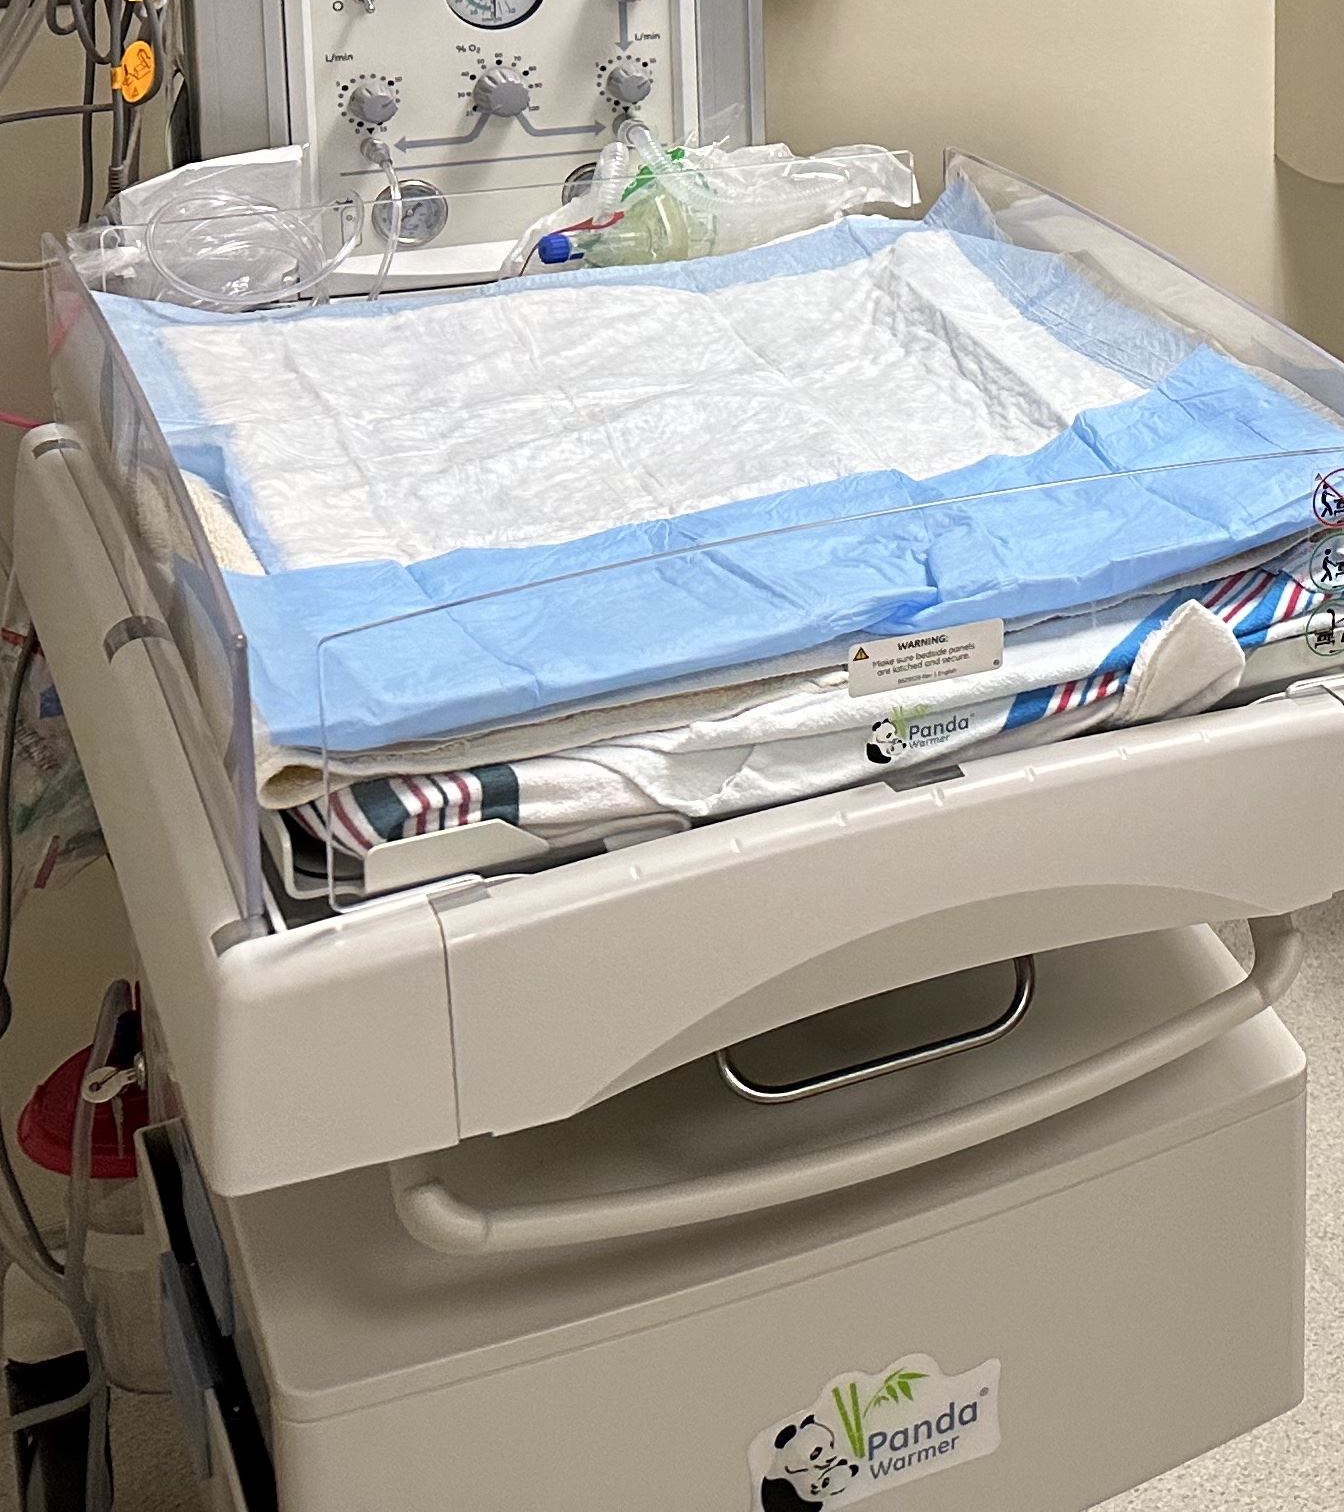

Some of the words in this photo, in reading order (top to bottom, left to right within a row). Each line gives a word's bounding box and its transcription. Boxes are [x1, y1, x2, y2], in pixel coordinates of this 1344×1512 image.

[635, 32, 661, 41] L/min
[325, 54, 353, 63] L/min
[897, 634, 949, 651] WARNING:
[872, 658, 895, 668] Make
[896, 654, 914, 664] sure
[916, 648, 947, 660] bedside
[948, 642, 975, 655] panels
[877, 668, 891, 676] are
[893, 660, 923, 672] latched
[924, 658, 940, 667] and
[909, 715, 969, 740] Panda
[909, 735, 950, 750] Warmer
[867, 1400, 979, 1460] Panda
[870, 1436, 960, 1479] Warmer
